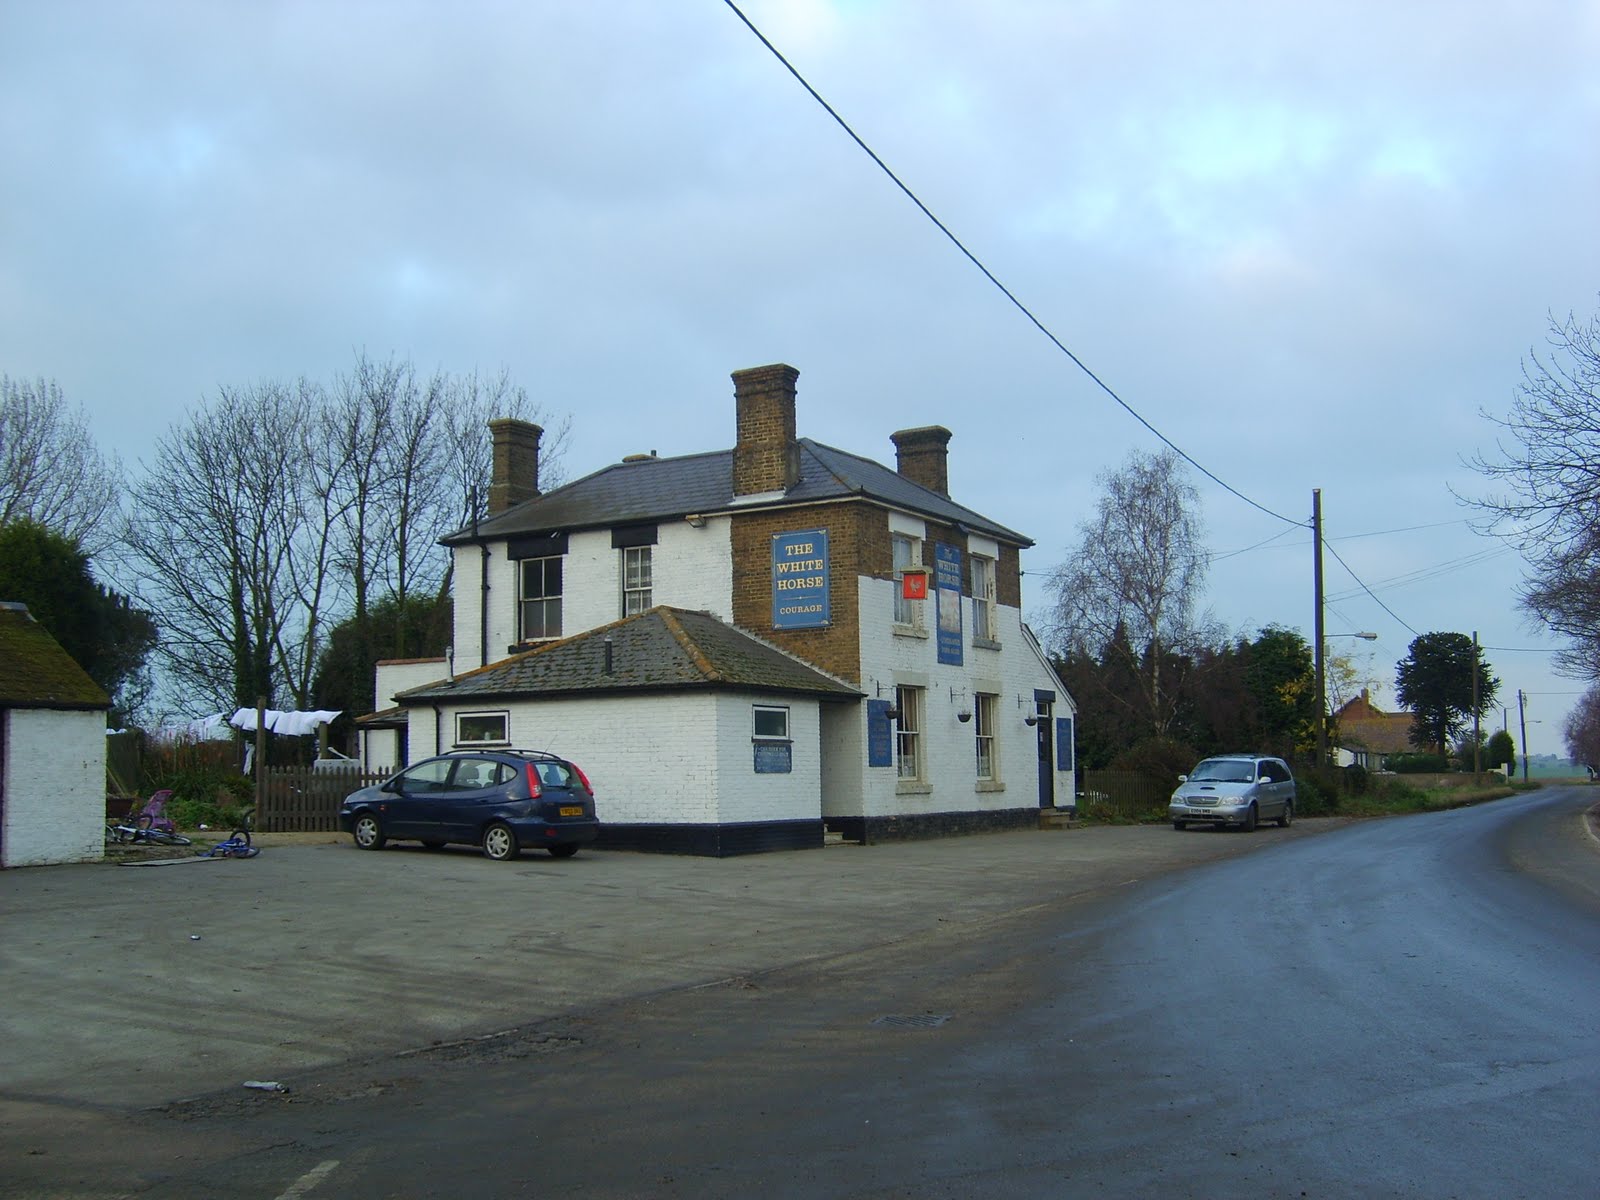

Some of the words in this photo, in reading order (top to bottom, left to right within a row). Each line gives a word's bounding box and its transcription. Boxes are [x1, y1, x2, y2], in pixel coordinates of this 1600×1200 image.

[785, 543, 813, 555] THE
[776, 559, 823, 573] WHITE
[938, 559, 959, 573] WHITE
[777, 576, 823, 590] HORSE
[938, 571, 960, 586] HORSE
[779, 604, 822, 615] COURAGE
